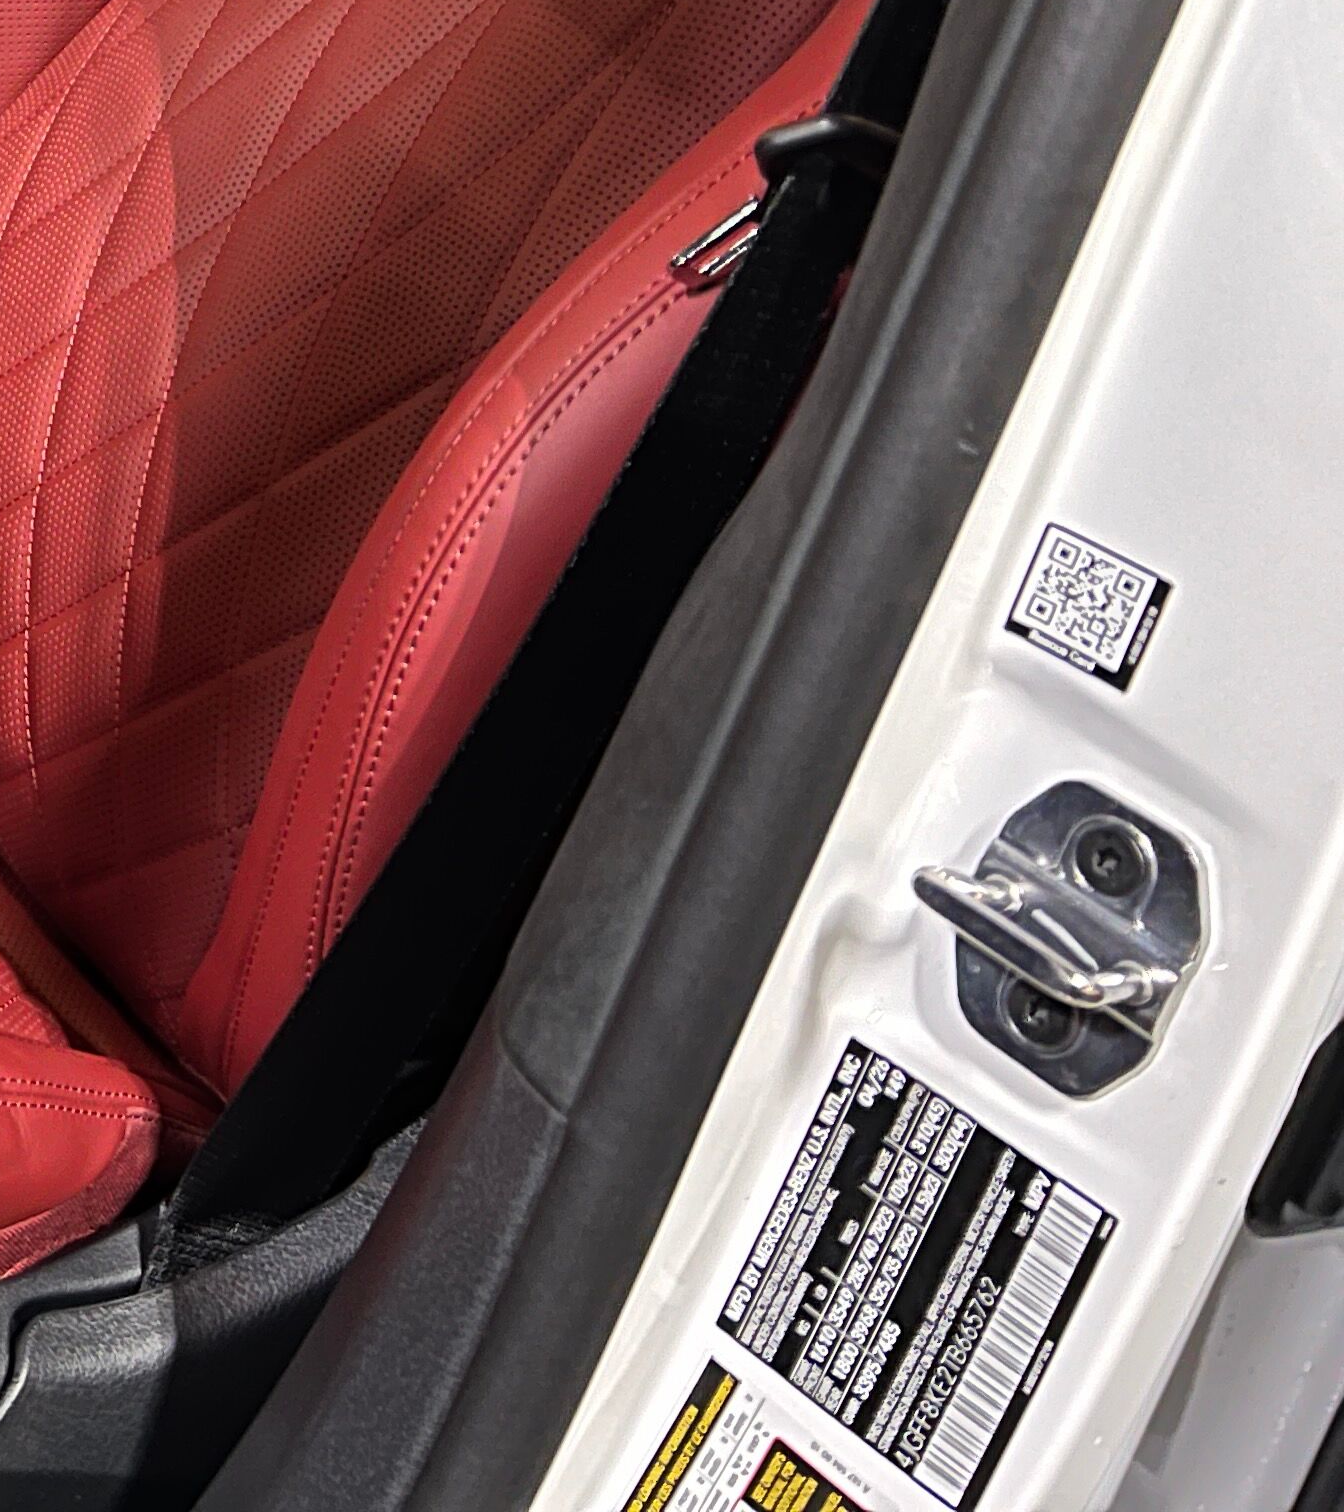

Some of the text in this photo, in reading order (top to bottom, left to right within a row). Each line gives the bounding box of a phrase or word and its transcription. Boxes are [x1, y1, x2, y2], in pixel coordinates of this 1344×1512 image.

[836, 1051, 863, 1088] INC
[855, 1055, 891, 1110] 04/26
[804, 1119, 831, 1156] U.S.
[750, 1149, 817, 1269] MERCEDES-BENZ
[725, 1284, 752, 1325] MFD
[741, 1261, 763, 1290] BY
[807, 1322, 839, 1366] 1610
[825, 1284, 857, 1330] 3549
[844, 1236, 882, 1292] 285/40
[830, 1339, 860, 1383] 1800
[848, 1301, 880, 1346] 3968
[866, 1253, 905, 1309] 325/35
[851, 1356, 884, 1402] 3395
[870, 1318, 903, 1364] 7485
[889, 1275, 1003, 1471] 4JGFF8KE2TB665762
